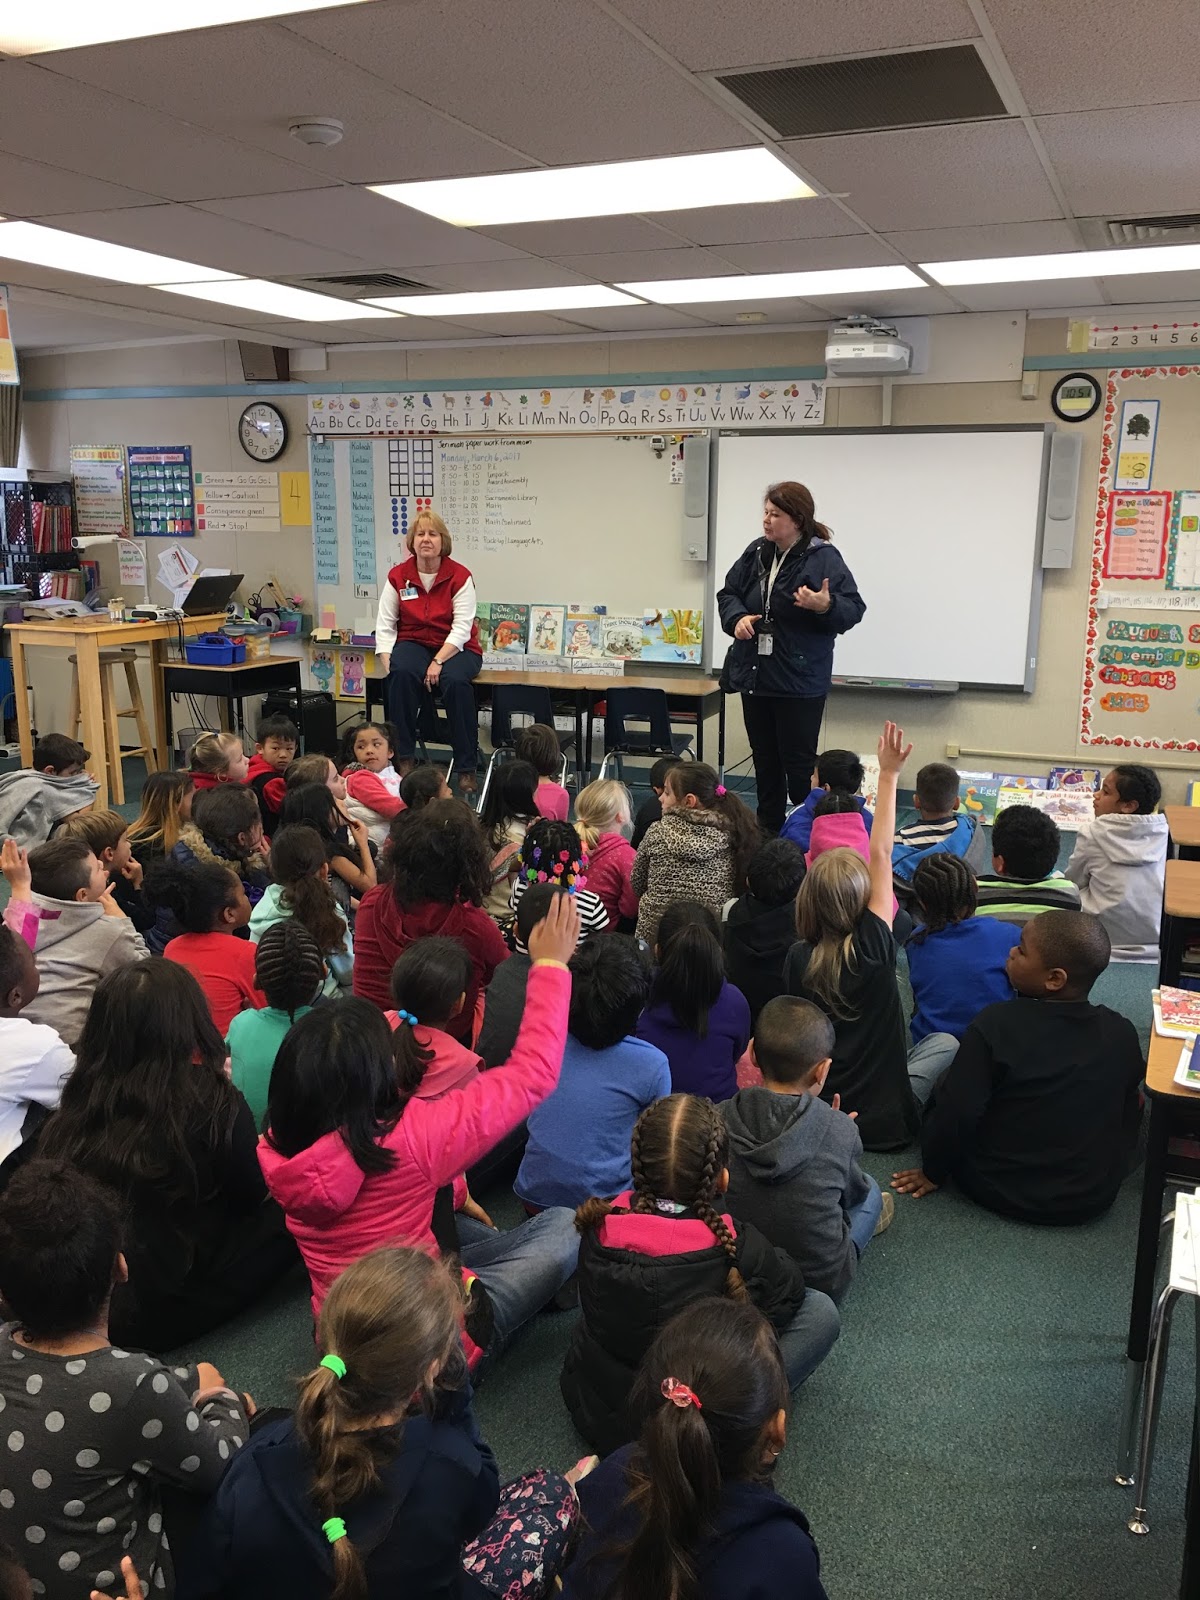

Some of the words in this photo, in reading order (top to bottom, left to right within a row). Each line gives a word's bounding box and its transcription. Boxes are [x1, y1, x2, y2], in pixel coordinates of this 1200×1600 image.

[1093, 337, 1098, 346] 1
[1111, 336, 1119, 346] 2
[1131, 335, 1138, 344] 3
[1150, 334, 1158, 344] 4
[1170, 334, 1178, 344] 5
[1190, 332, 1198, 342] 6
[251, 412, 256, 420] 11
[258, 408, 266, 416] 12
[310, 416, 325, 428] Aa
[329, 416, 343, 428] Bb
[347, 416, 361, 428] Cc
[365, 415, 380, 428] Dd
[386, 415, 399, 428] Ee
[404, 414, 414, 428] Ff
[420, 414, 438, 430] Gg
[443, 414, 459, 427] Hh
[465, 413, 472, 426] Ii
[481, 412, 490, 428] Jj
[498, 412, 514, 426] Kk
[519, 412, 528, 426] Ll
[532, 412, 556, 426] Mm
[559, 411, 576, 424] Nn
[580, 410, 596, 424] Oo
[601, 410, 616, 426] Pp
[618, 410, 636, 426] Qq
[642, 409, 655, 423] Rr
[658, 408, 672, 423] Ss
[676, 408, 686, 422] Tt
[690, 408, 706, 422] Uu
[710, 407, 726, 421] Vv
[730, 406, 754, 420] Ww
[759, 406, 777, 420] Xx
[782, 405, 796, 422] Yy
[804, 404, 820, 419] Zz
[274, 420, 280, 428] 2
[245, 429, 250, 437] 9
[248, 438, 254, 446] 8
[74, 450, 95, 459] CLASS
[98, 450, 120, 460] RULES
[262, 448, 268, 456] 6
[270, 444, 276, 453] 5
[472, 453, 492, 462] March
[502, 452, 520, 460] 2017
[204, 475, 224, 484] Green
[205, 490, 223, 498] Yellow
[231, 491, 258, 500] Caution!
[290, 478, 301, 512] 4
[518, 494, 538, 505] Library
[206, 506, 246, 516] Consequence
[316, 512, 332, 523] Bryan
[208, 520, 220, 529] Red
[228, 521, 248, 532] Stop!
[356, 584, 368, 597] Kim
[514, 614, 526, 623] Day
[1108, 622, 1180, 641] August
[1101, 646, 1182, 662] November
[1104, 668, 1168, 686] February
[1110, 696, 1145, 708] May
[980, 786, 997, 796] Egg
